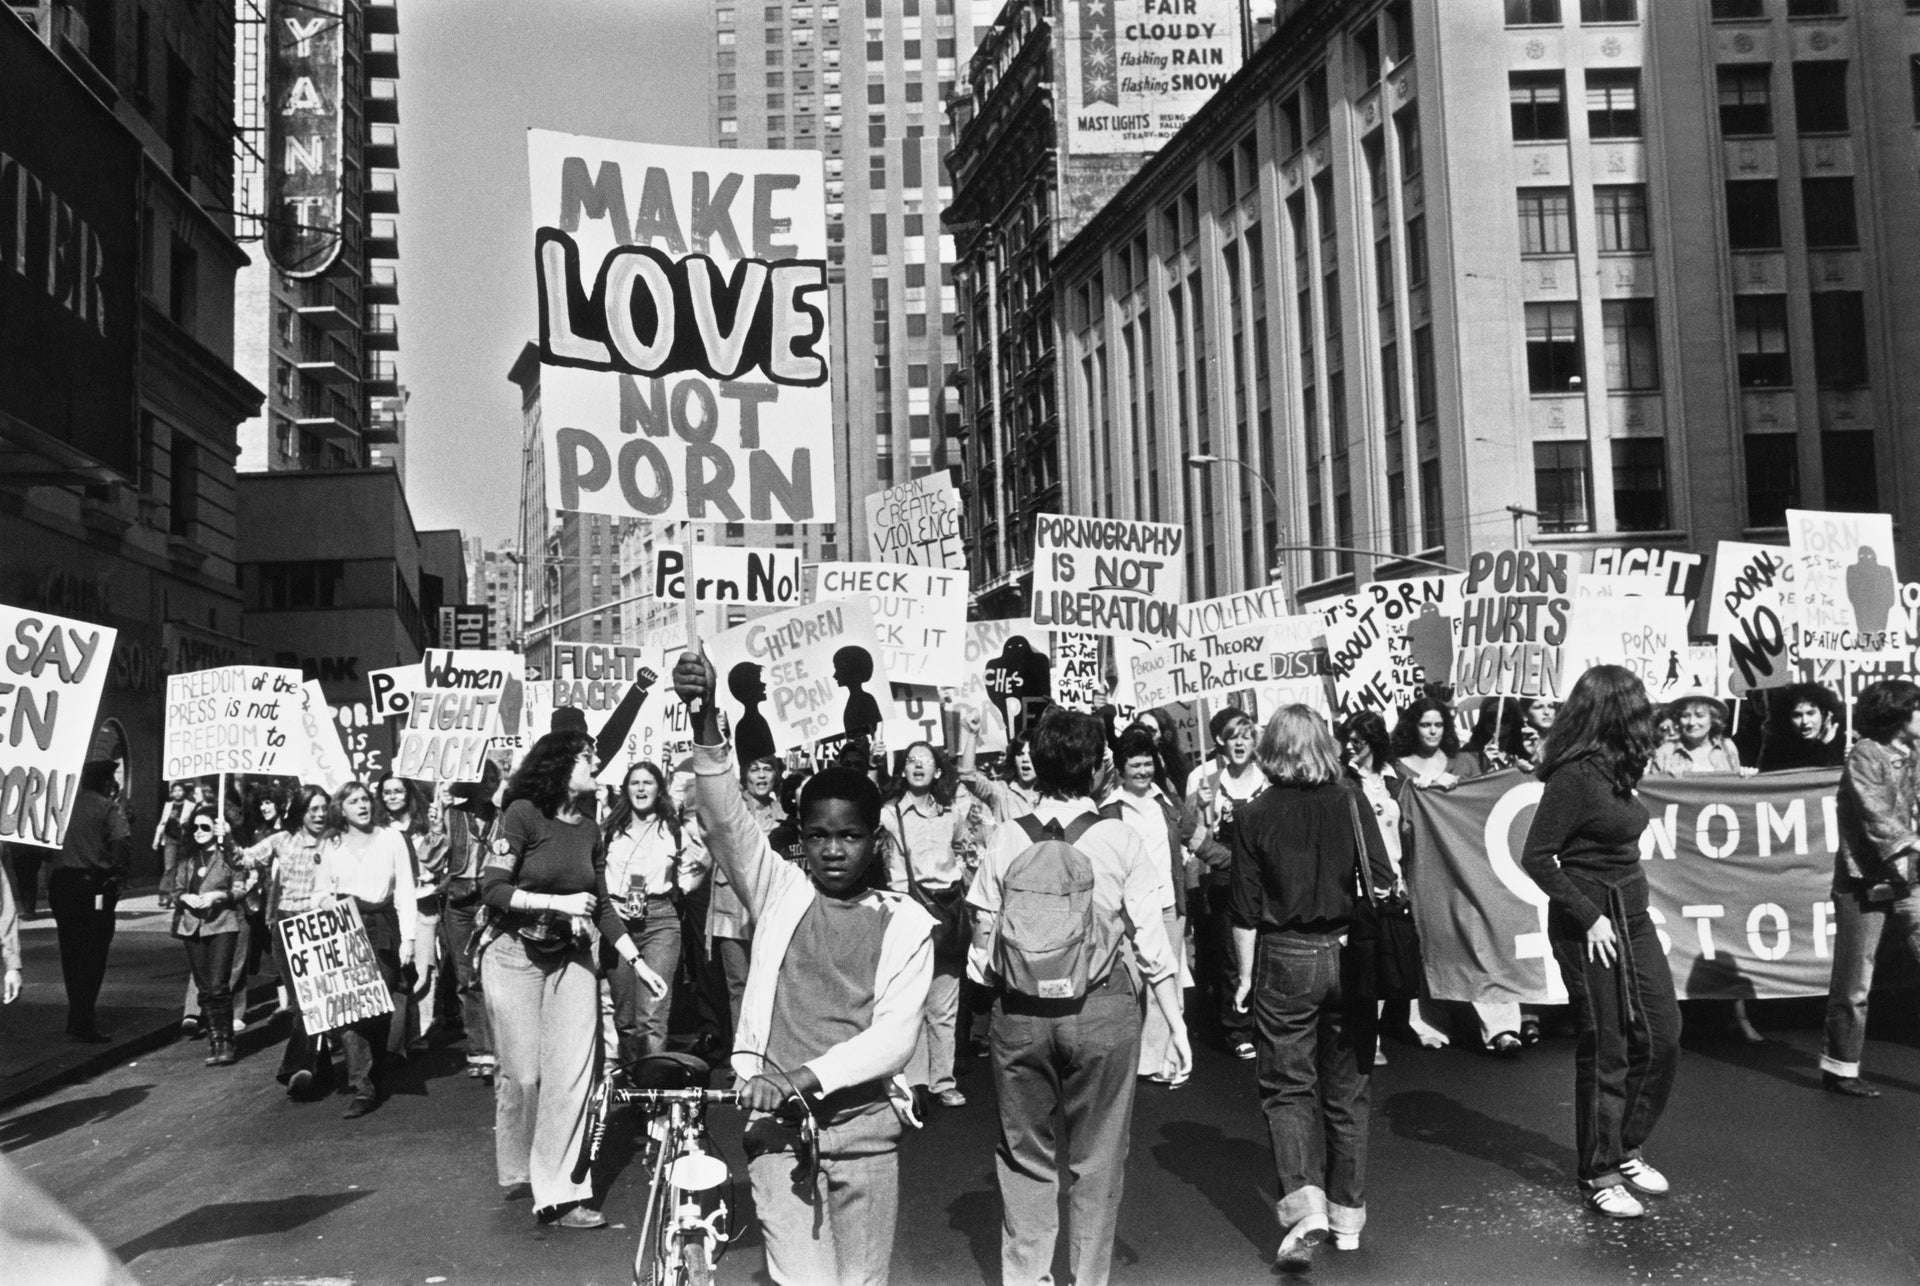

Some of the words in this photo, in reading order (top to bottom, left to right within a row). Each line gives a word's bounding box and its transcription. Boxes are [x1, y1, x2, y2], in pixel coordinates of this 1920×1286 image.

[1145, 0, 1197, 15] FAIR
[1126, 23, 1217, 41] CLOUDY
[1120, 51, 1168, 70] flashing
[1172, 48, 1223, 65] RAIN
[1121, 76, 1169, 95] flashing
[1171, 73, 1227, 91] SNOW
[1078, 116, 1109, 131] MAST
[1111, 113, 1150, 130] LIGHTS
[559, 156, 800, 260] MAKE
[535, 226, 829, 388] LOVE
[619, 373, 779, 449] NOT
[556, 427, 815, 522] PORN
[882, 477, 923, 508] PORN
[876, 489, 947, 528] CREATES
[873, 508, 959, 553] VIOLENCE
[1038, 516, 1182, 556] PORNOGRAPHY
[747, 552, 801, 603] No!
[1052, 552, 1075, 583] IS
[1094, 554, 1164, 593] NOT
[1466, 549, 1568, 596] PORN
[1800, 553, 1822, 569] IS
[824, 571, 909, 594] CHECK
[926, 575, 954, 597] IT
[1368, 578, 1445, 620] PORN
[1725, 549, 1777, 619] PORN
[457, 613, 484, 650] RO
[745, 606, 845, 662] CHILDREN
[1034, 590, 1179, 640] LIBERATION
[1461, 595, 1571, 649] HURTS
[6, 617, 100, 684] SAY
[923, 627, 948, 649] IT
[965, 619, 1010, 663] ORN
[1058, 644, 1078, 659] IS
[1079, 642, 1098, 659] THE
[1332, 606, 1381, 683] ABOUT
[1387, 635, 1415, 652] RT
[1621, 624, 1667, 656] PORN
[1729, 604, 1785, 689] NO
[1803, 629, 1839, 651] DEATH
[1840, 629, 1900, 652] CULTURE
[424, 650, 504, 690] Women
[553, 644, 642, 682] FIGHT
[770, 659, 809, 686] SEE
[1063, 659, 1097, 678] ART
[1391, 666, 1426, 687] ALE
[1456, 644, 1566, 699] WOMEN
[170, 668, 247, 702] FREEDOM
[251, 672, 269, 692] of
[272, 674, 298, 695] the
[371, 672, 415, 714] Po
[552, 680, 623, 711] BACK
[772, 676, 834, 723] PORN
[169, 697, 217, 728] PRESS
[224, 697, 241, 718] is
[246, 698, 281, 721] not
[409, 692, 500, 732] FIGHT
[169, 723, 258, 755] FREEDOM
[266, 725, 287, 748] to
[346, 727, 369, 751] is
[168, 749, 253, 777] OPPRESS
[0, 765, 77, 846] ORN
[1638, 796, 1839, 861] WOM
[290, 948, 309, 978] OF
[312, 938, 344, 972] THE
